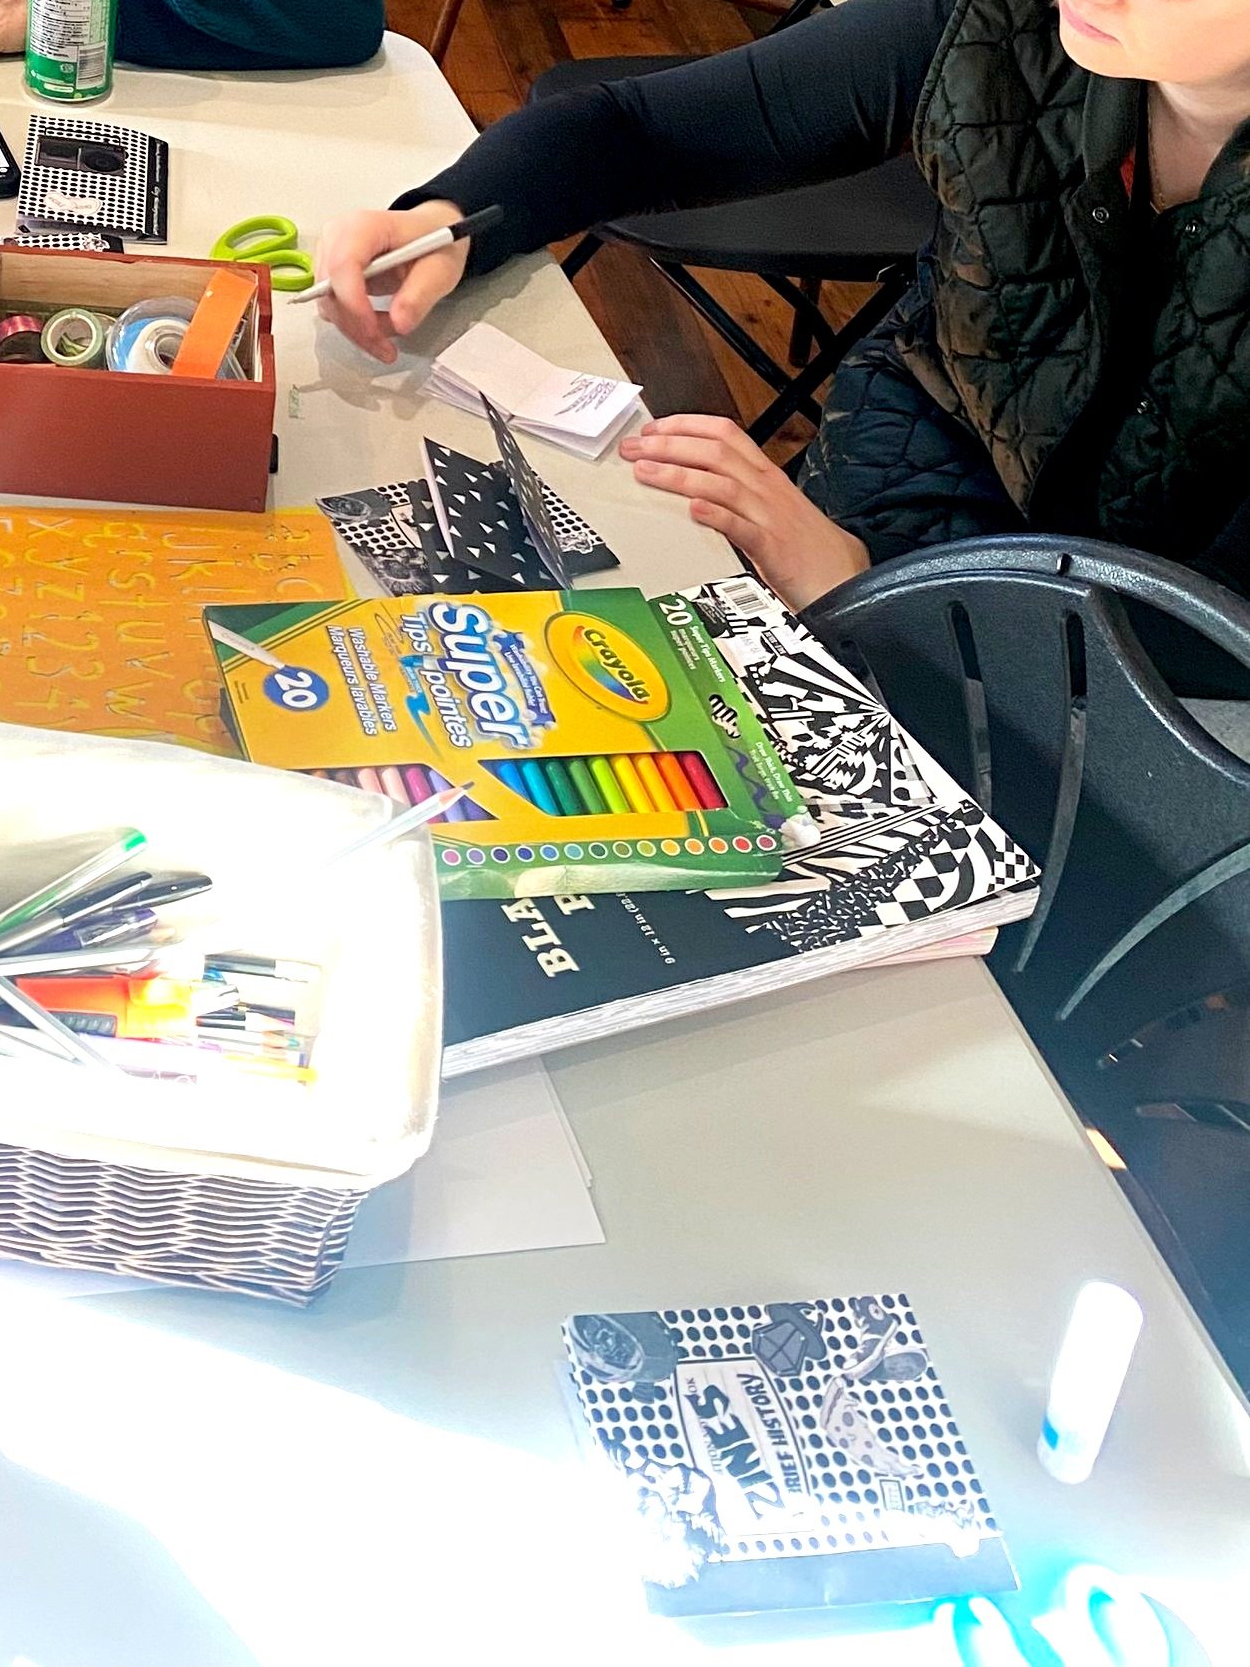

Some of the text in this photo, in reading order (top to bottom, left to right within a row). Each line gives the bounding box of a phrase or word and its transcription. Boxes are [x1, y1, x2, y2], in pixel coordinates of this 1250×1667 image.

[659, 598, 693, 625] 20
[402, 612, 434, 653] Tips
[678, 629, 700, 661] marqueurs
[431, 602, 530, 748] Super
[584, 628, 650, 700] Crayola
[690, 626, 726, 683] Super Tips Markers
[274, 672, 318, 707] 20
[328, 625, 377, 736] Marqueurs lavables
[348, 627, 378, 682] Washable
[367, 683, 397, 731] Markers
[534, 686, 543, 698] Can
[420, 669, 471, 748] pointes
[633, 913, 647, 927] in
[640, 923, 656, 939] 12
[656, 944, 671, 959] in
[664, 954, 677, 967] 9
[736, 1374, 789, 1446] HISTORY
[684, 1385, 785, 1520] ZINES
